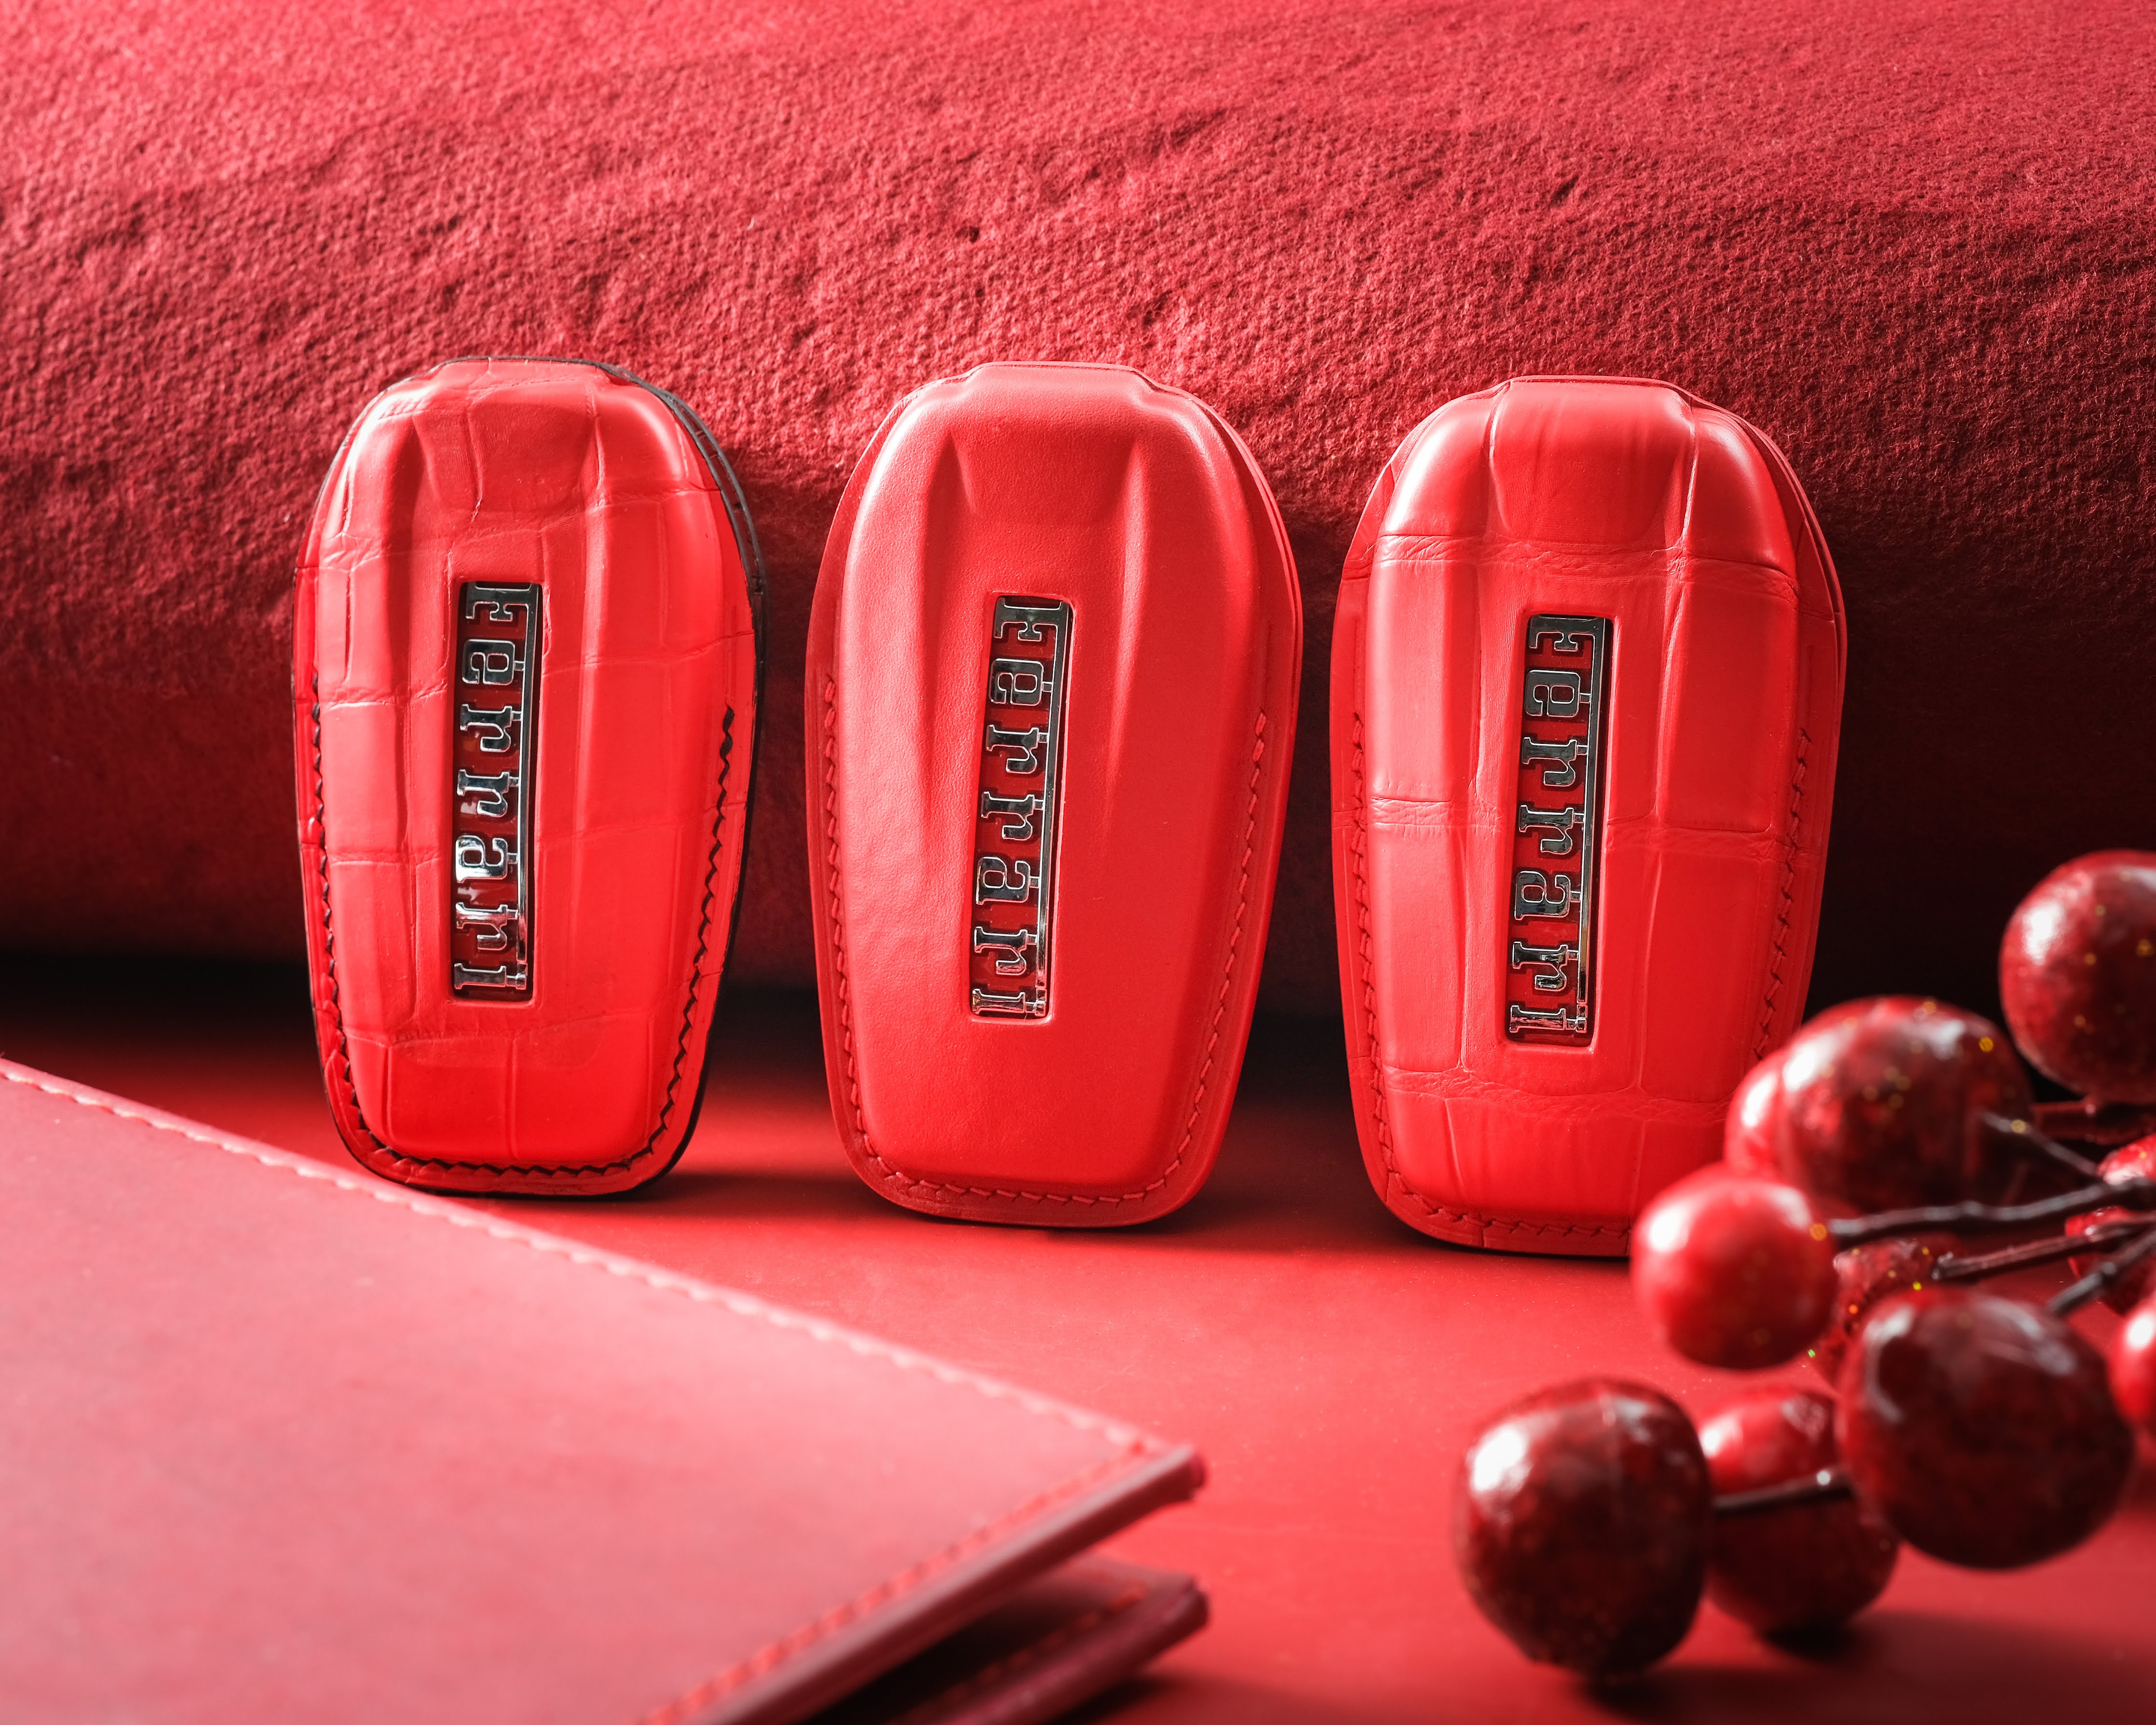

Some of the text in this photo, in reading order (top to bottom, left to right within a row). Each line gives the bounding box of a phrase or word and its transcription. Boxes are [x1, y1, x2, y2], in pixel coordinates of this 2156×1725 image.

[454, 581, 539, 990] Ferrari
[972, 598, 1068, 1016] Ferrari
[1509, 615, 1606, 1033] Ferrari
